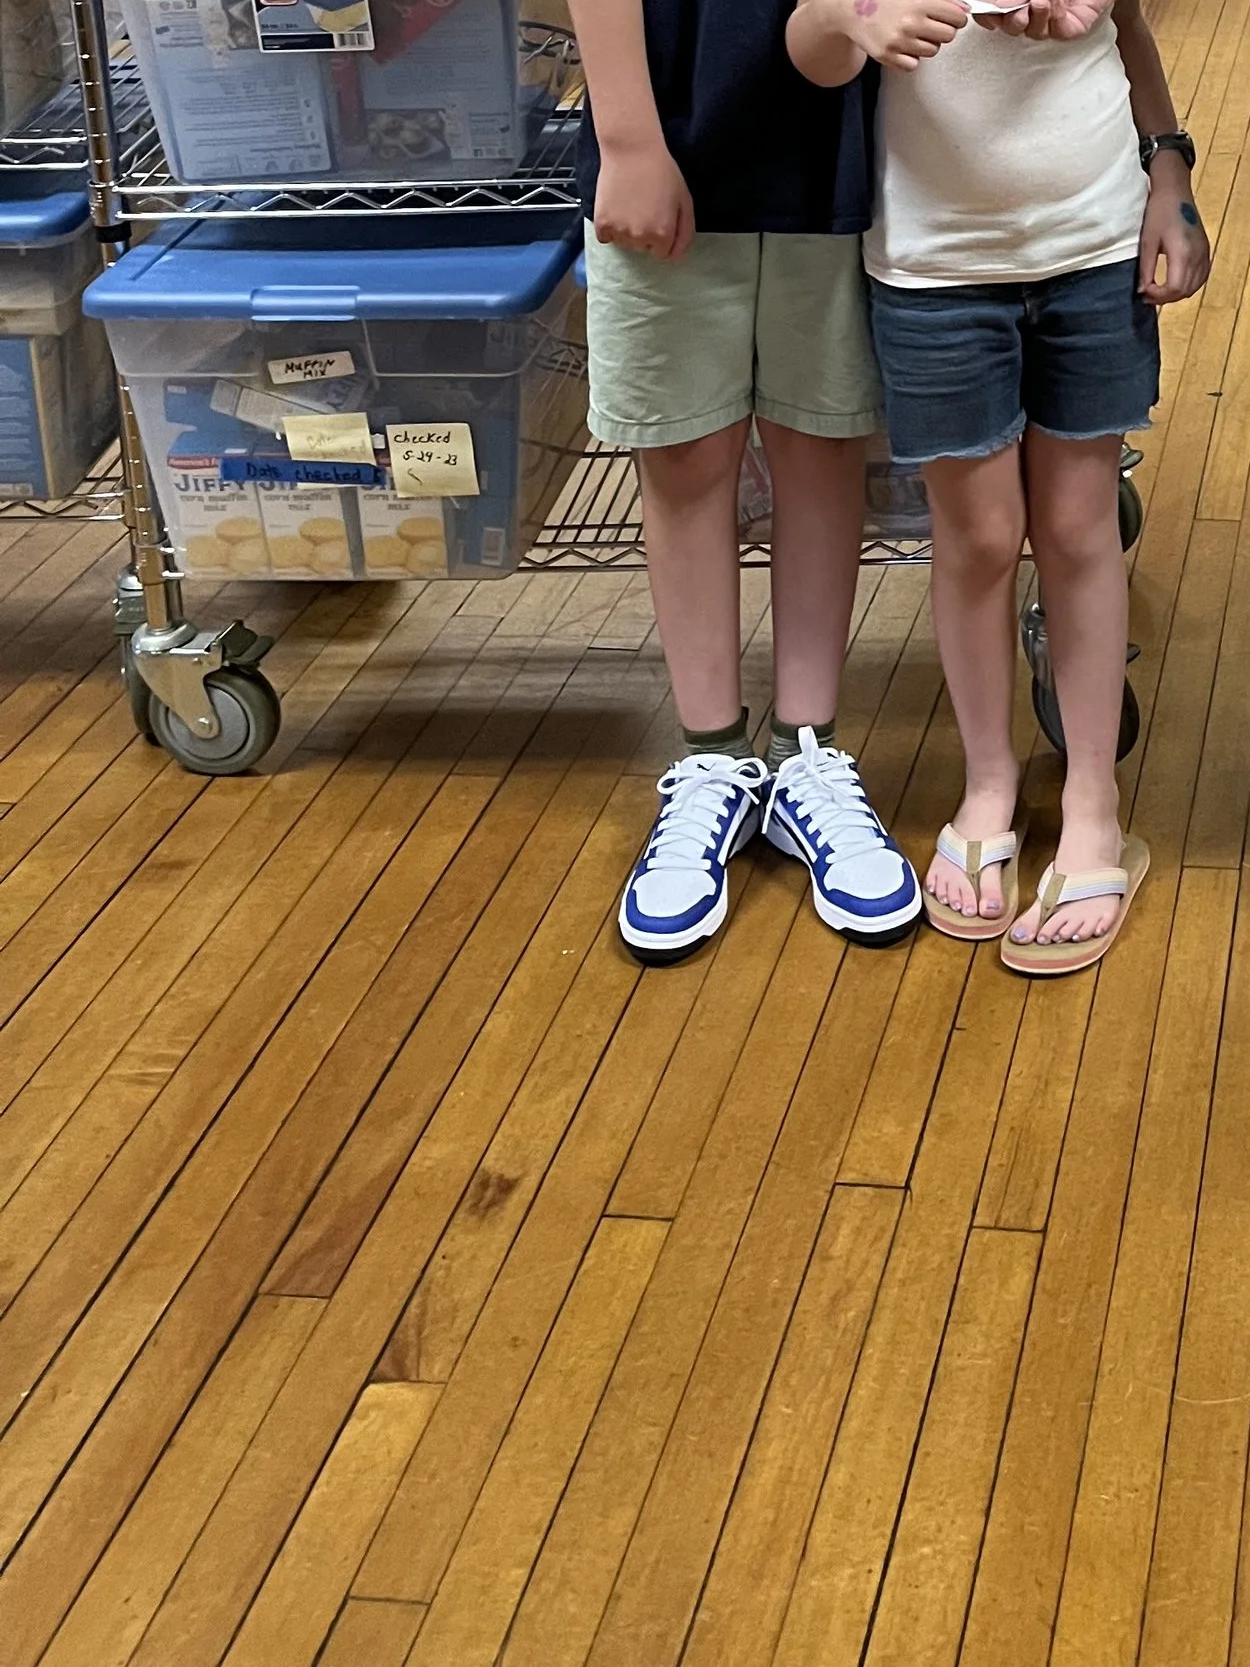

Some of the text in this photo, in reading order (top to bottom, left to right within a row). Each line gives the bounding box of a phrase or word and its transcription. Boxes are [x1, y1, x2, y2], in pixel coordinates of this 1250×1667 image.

[284, 359, 336, 373] MUFFIN
[303, 369, 326, 379] MIX
[394, 430, 451, 443] checked
[246, 462, 281, 479] Date
[295, 464, 361, 482] checked
[174, 474, 246, 492] JIFFY
